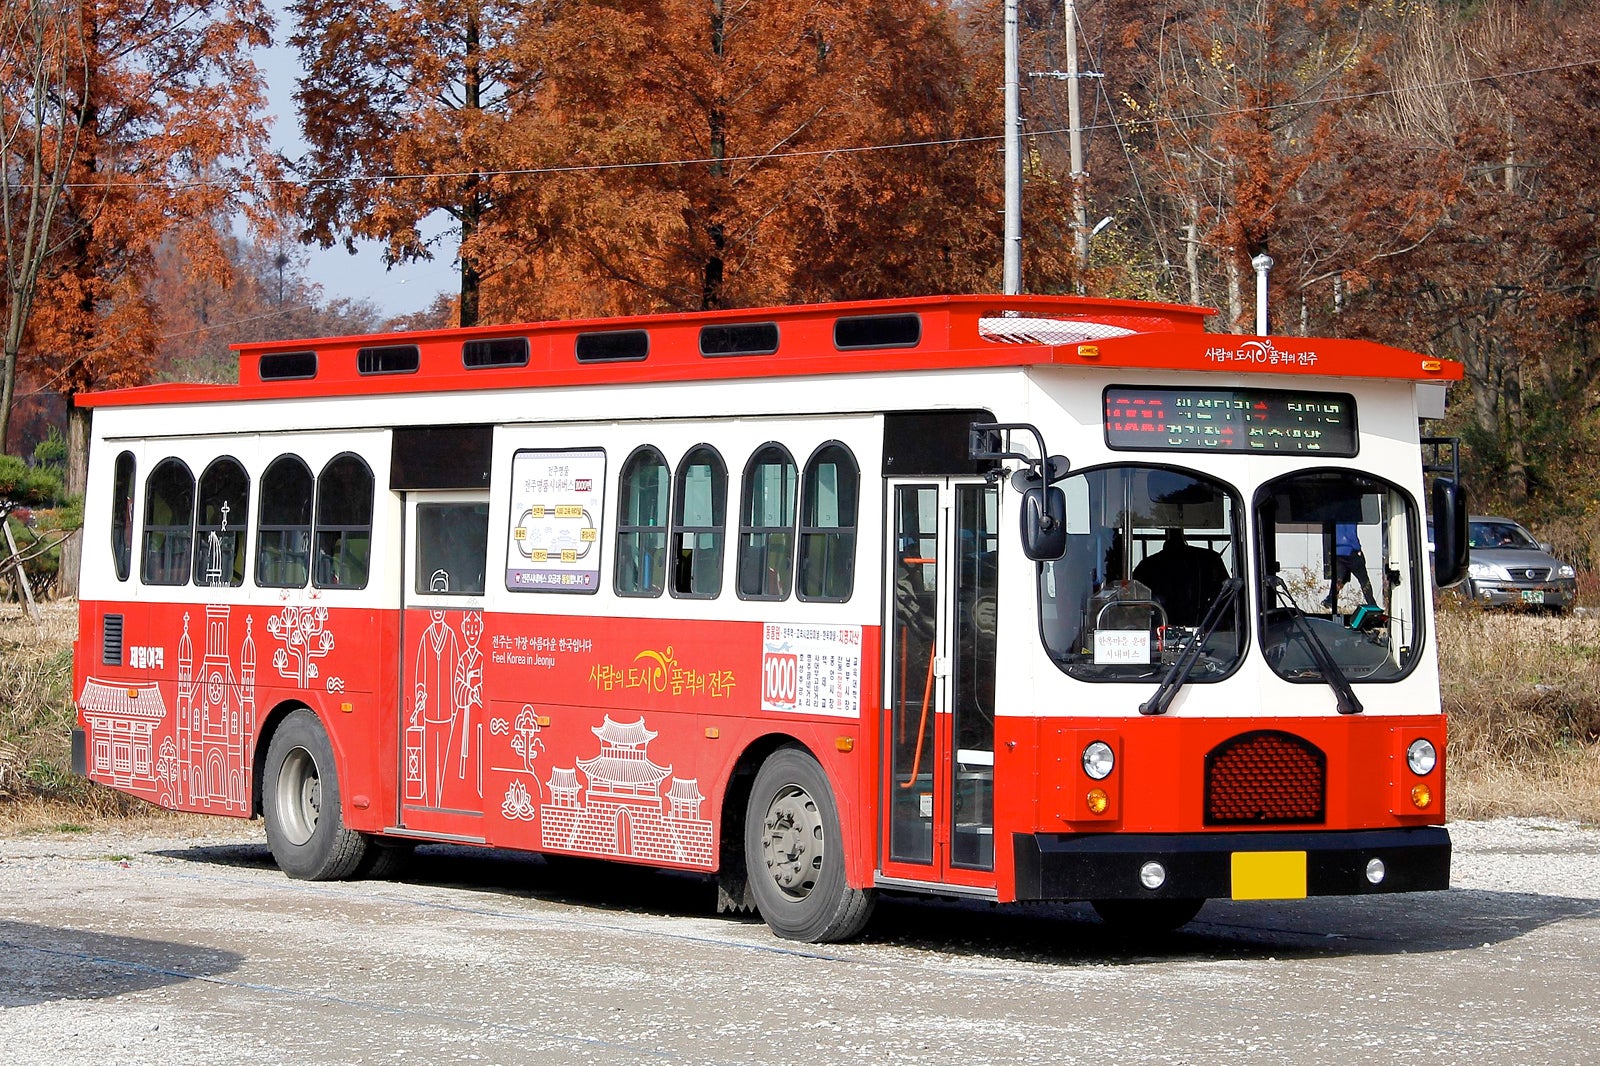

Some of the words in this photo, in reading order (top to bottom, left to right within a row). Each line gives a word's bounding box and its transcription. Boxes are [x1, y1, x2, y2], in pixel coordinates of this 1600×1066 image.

[1205, 348, 1233, 363] 사람의
[1235, 349, 1254, 363] 도시
[1268, 350, 1296, 365] 품격의
[1298, 352, 1318, 366] 전주
[492, 636, 512, 650] 전주는
[514, 637, 528, 650] 가장
[530, 637, 556, 652] 아름다운
[558, 638, 592, 653] 한국입니다
[130, 646, 164, 670] 제일여객
[492, 652, 506, 664] Feel
[506, 652, 526, 665] Korea
[526, 654, 533, 664] in
[534, 654, 555, 670] Jeonju
[1106, 649, 1140, 659] 시내버스
[588, 664, 624, 692] 사람의
[626, 668, 651, 694] 도시
[670, 668, 705, 696] 품격의
[708, 670, 737, 698] 전주
[765, 656, 796, 700] 1000
